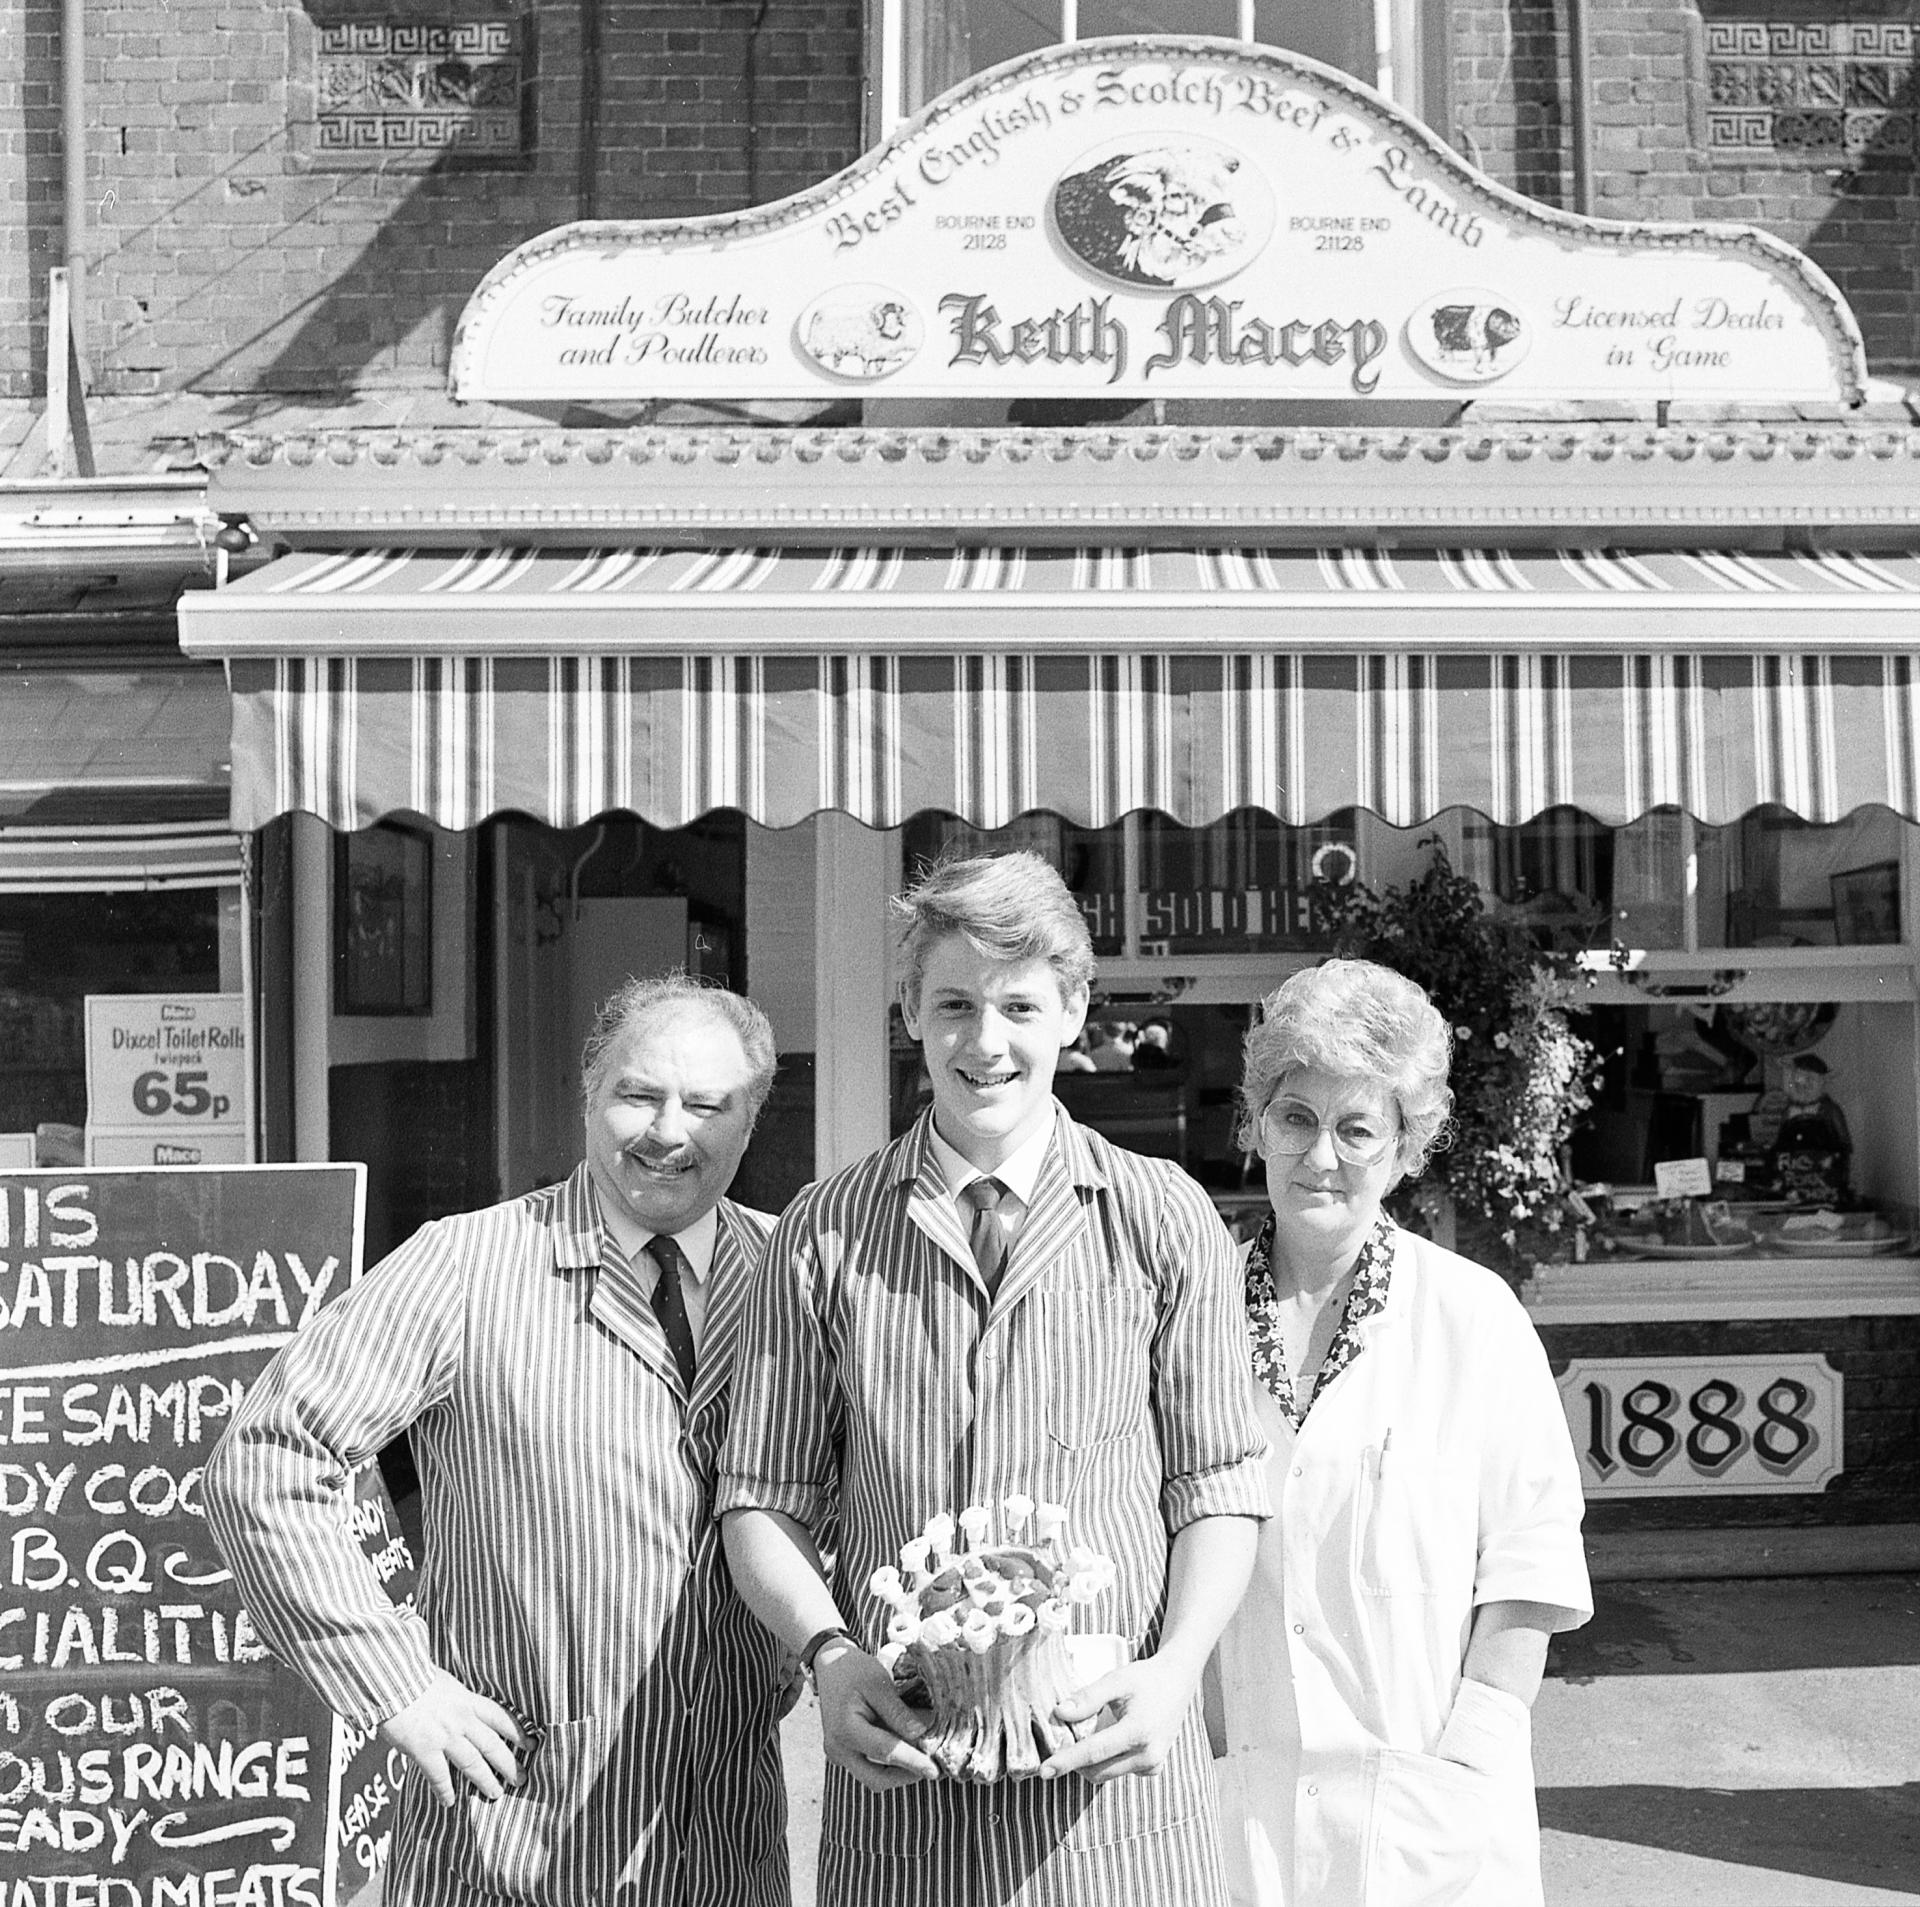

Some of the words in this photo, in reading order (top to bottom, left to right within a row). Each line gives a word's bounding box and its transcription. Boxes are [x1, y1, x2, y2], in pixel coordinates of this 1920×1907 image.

[825, 177, 916, 250] Best
[919, 93, 1051, 186] English
[1060, 89, 1085, 116] &
[1095, 68, 1223, 114] Scotch
[1231, 74, 1330, 132] Beef
[1330, 126, 1361, 150] &
[1370, 146, 1483, 248] Lamb
[935, 215, 1001, 230] BOURNE
[1005, 215, 1035, 229] END
[963, 233, 1007, 251] 21128
[1289, 217, 1355, 232] BOURNE
[1360, 217, 1391, 232] END
[1315, 235, 1364, 252] 21128
[540, 294, 644, 334] Family
[649, 291, 768, 328] Butcher
[1552, 296, 1683, 328] Licensed
[1691, 297, 1785, 329] Dealer
[558, 333, 621, 365] and
[625, 331, 768, 366] Poulterers
[938, 294, 1127, 384] Keith
[1144, 294, 1387, 395] Macey
[1606, 343, 1633, 366] in
[1647, 334, 1732, 372] Game
[1146, 892, 1246, 935] SOLD
[112, 1027, 160, 1051] Dixcel
[164, 1026, 205, 1049] Toilet
[132, 1070, 230, 1119] 65p
[1583, 1377, 1819, 1482] 1888
[46, 1686, 195, 1736] OUR
[122, 1736, 312, 1802] RANGE
[0, 1873, 142, 1907] ATED
[151, 1863, 322, 1907] MEATS
